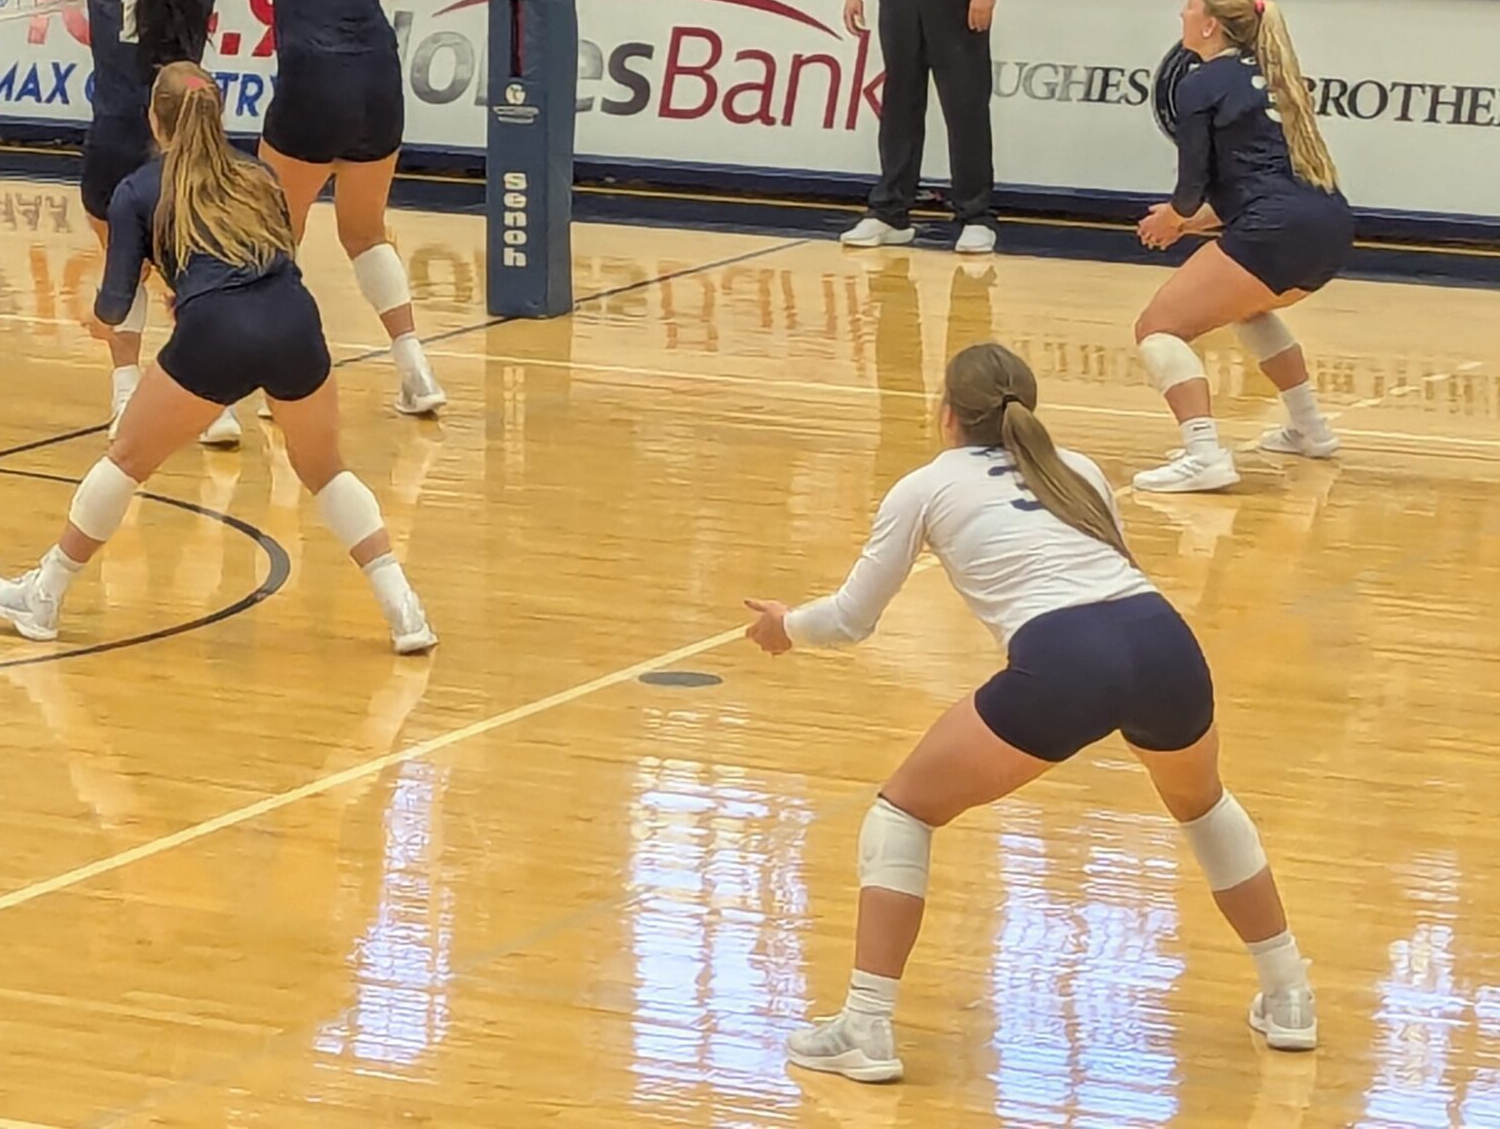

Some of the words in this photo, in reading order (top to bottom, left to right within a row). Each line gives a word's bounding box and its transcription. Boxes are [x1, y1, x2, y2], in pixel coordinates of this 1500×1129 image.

[393, 11, 887, 131] osBank
[992, 61, 1150, 106] UGHES
[1300, 76, 1500, 127] ROTHE
